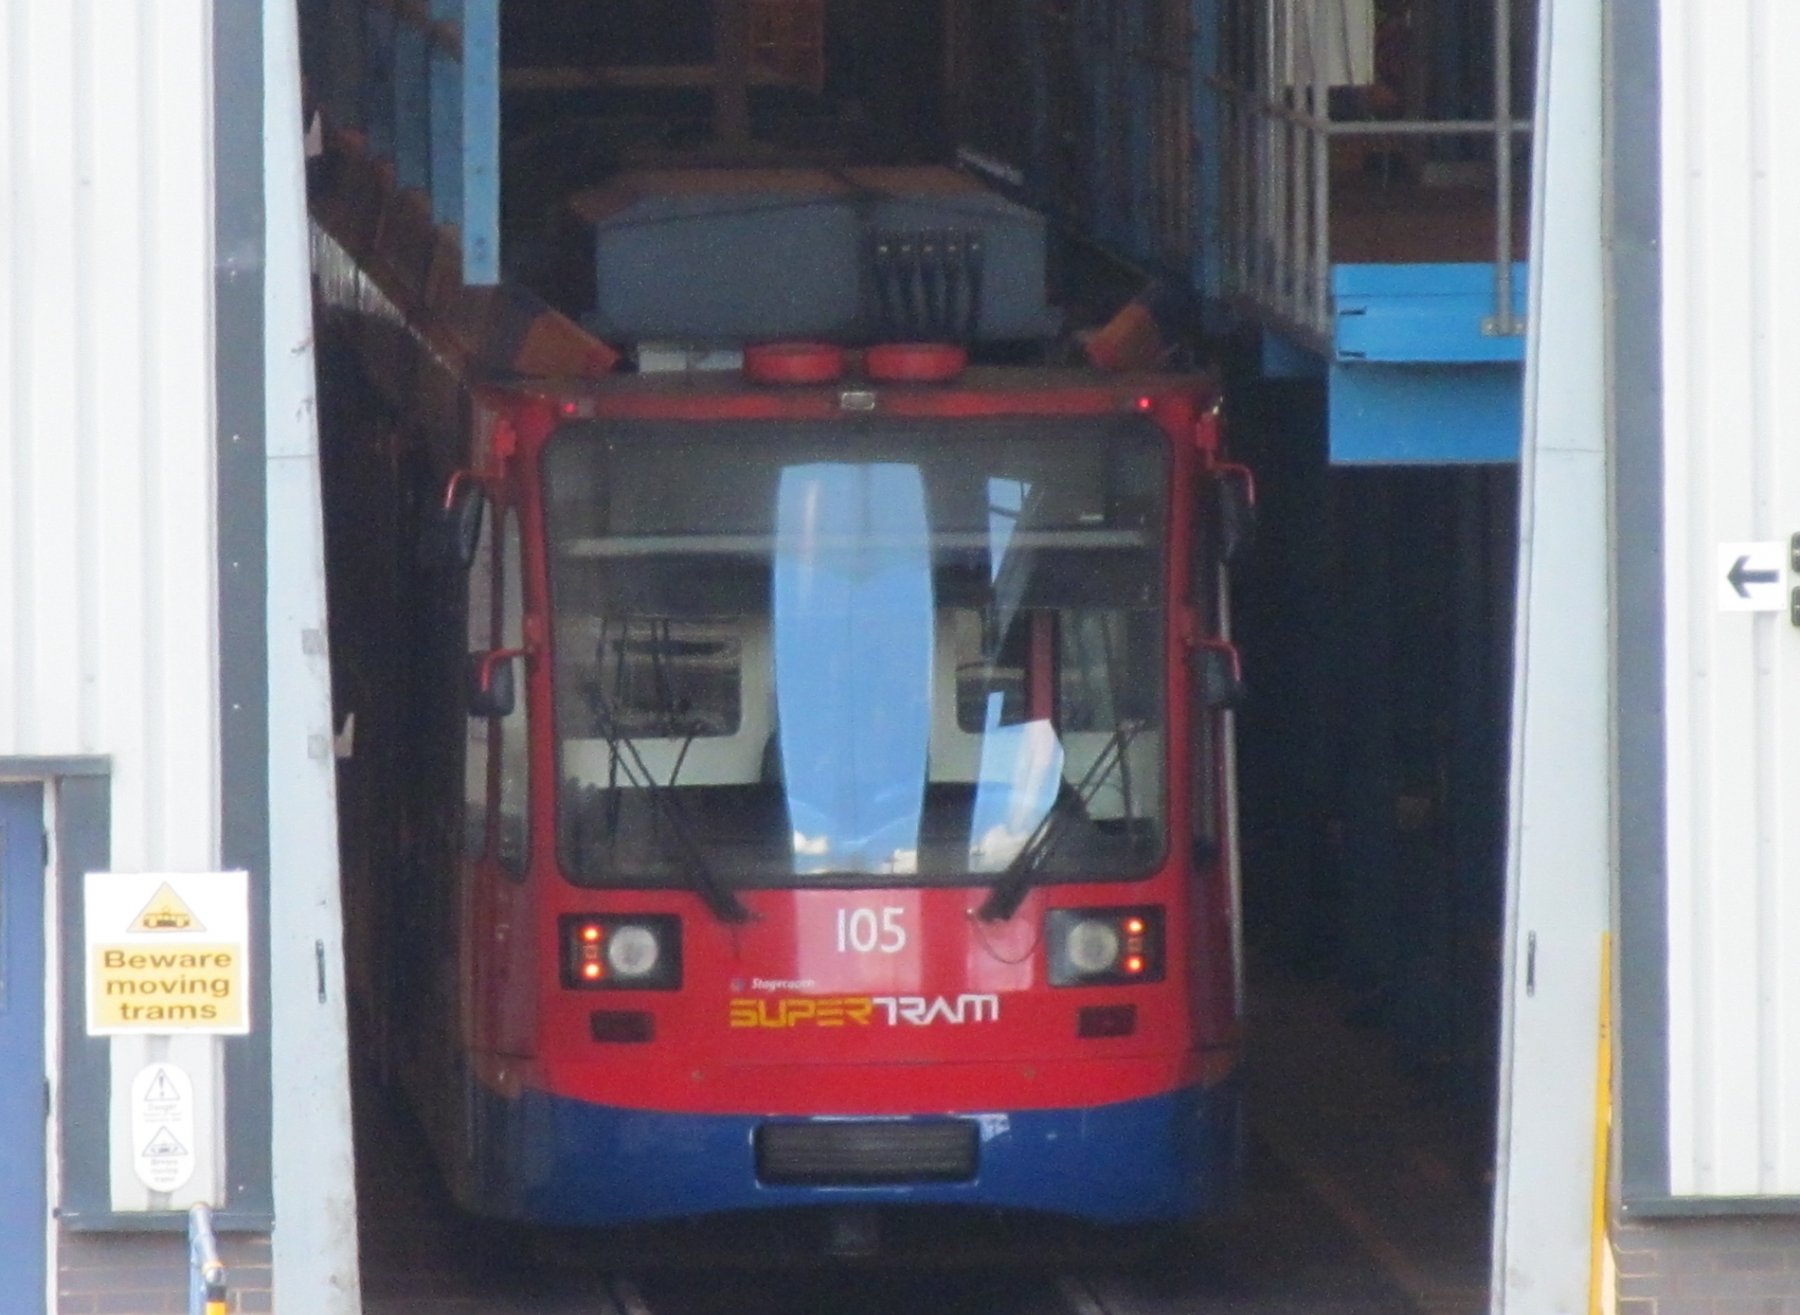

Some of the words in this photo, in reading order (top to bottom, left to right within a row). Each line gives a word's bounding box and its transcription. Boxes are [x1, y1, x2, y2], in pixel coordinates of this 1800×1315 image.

[835, 906, 906, 953] 105
[103, 949, 232, 969] Beware
[106, 973, 230, 998] moving
[120, 1002, 217, 1020] trams
